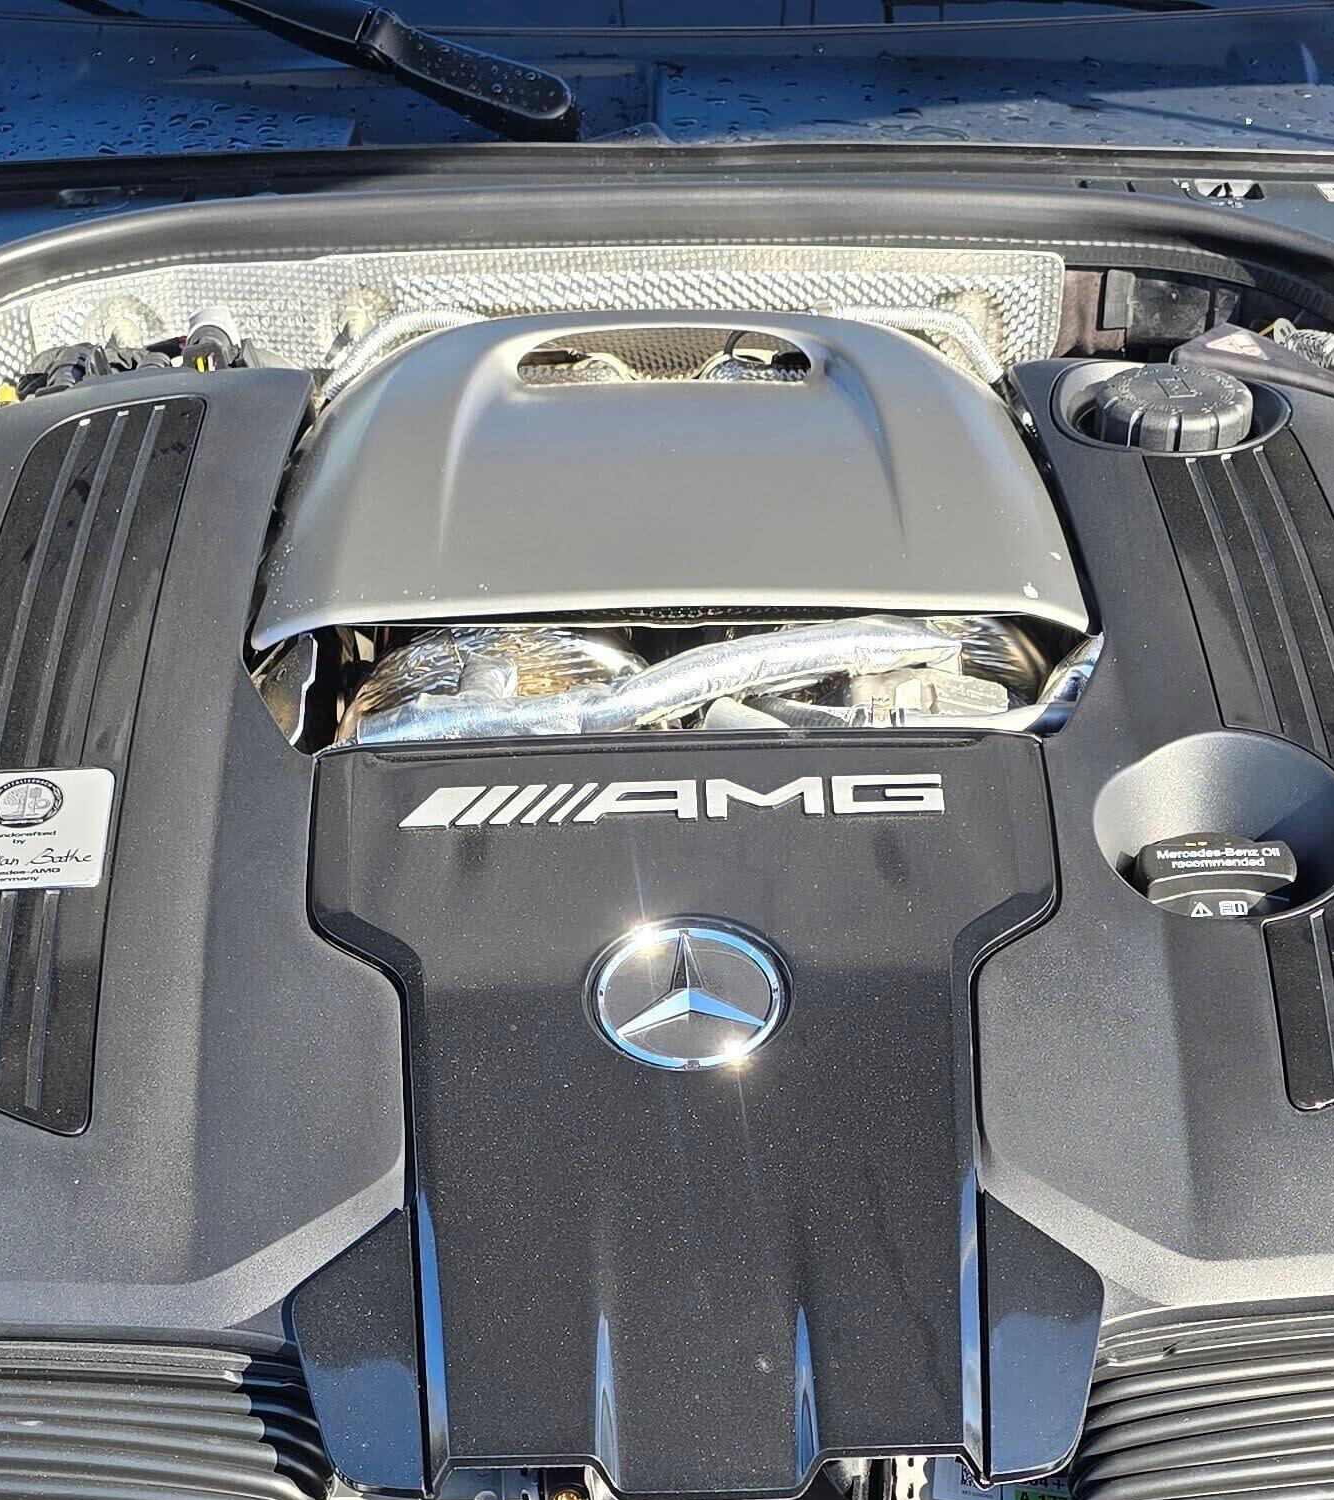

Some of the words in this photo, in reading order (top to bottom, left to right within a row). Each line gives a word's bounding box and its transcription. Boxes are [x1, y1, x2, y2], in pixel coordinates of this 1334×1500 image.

[573, 774, 944, 823] AMG
[1156, 847, 1259, 859] Mercedes-Benz
[1261, 847, 1280, 857] Oil
[1171, 857, 1265, 868] recommended
